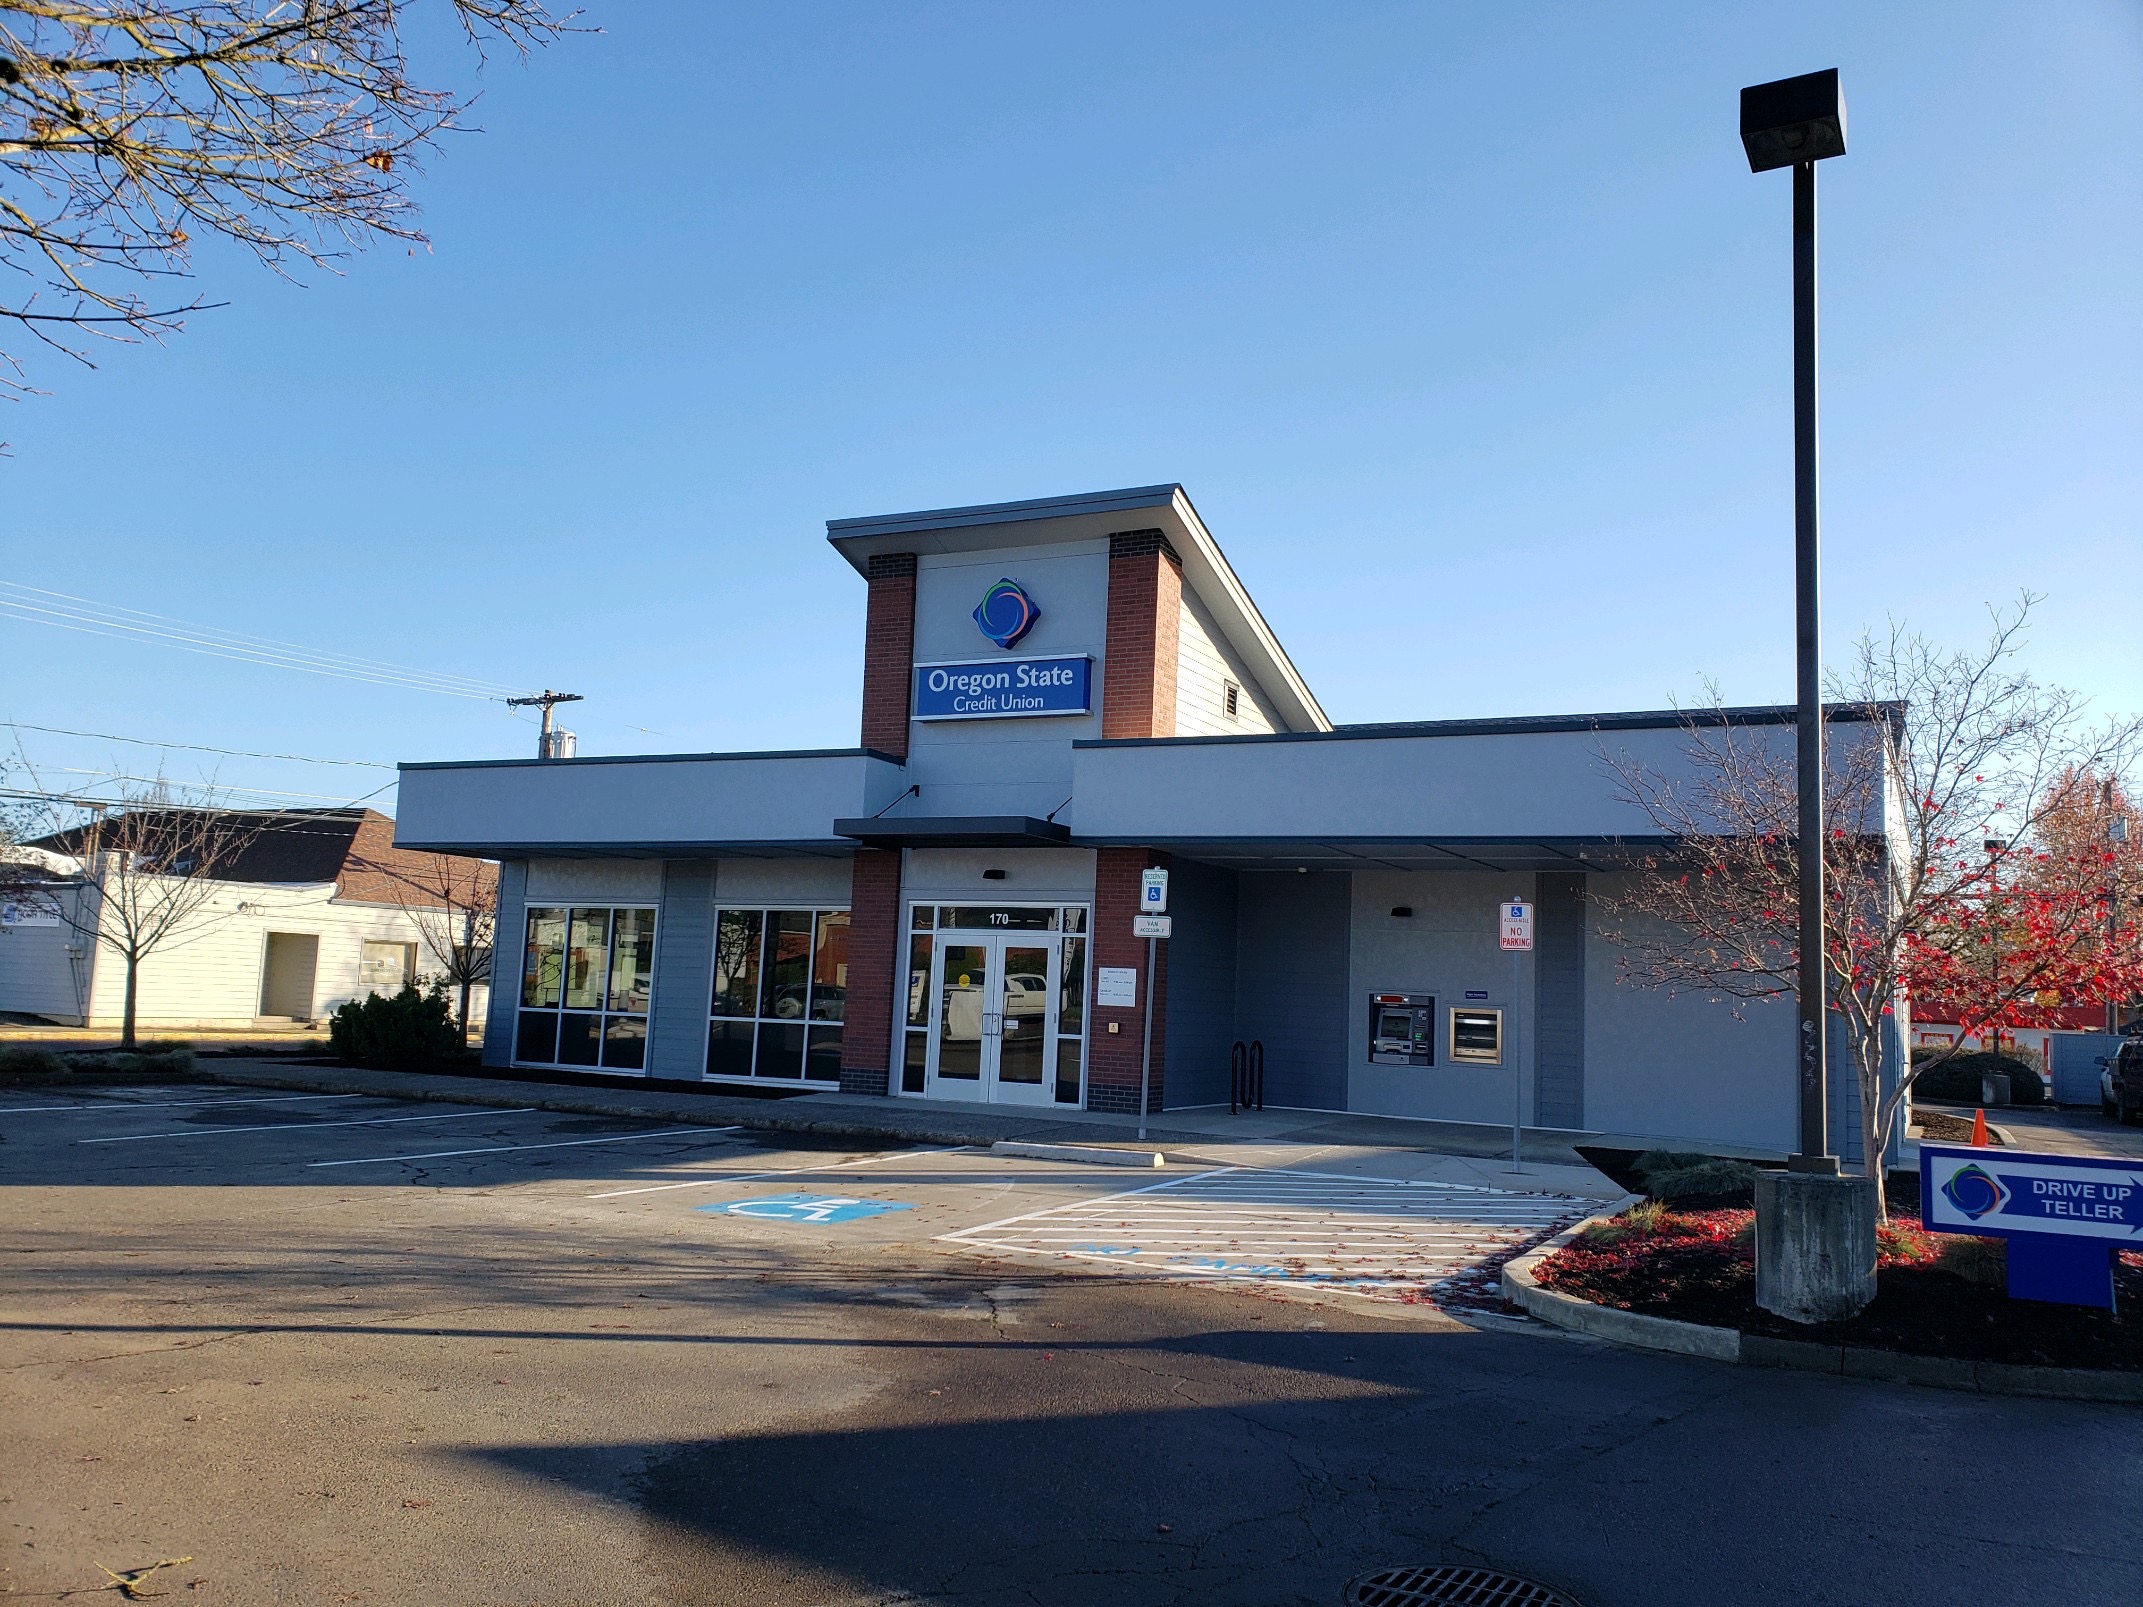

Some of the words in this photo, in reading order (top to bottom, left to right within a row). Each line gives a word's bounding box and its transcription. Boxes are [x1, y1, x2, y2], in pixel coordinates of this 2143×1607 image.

[928, 669, 1010, 696] Oregon
[1016, 665, 1073, 688] State
[953, 694, 997, 712] Credit
[1001, 693, 1044, 710] Union
[989, 913, 1009, 925] 170
[1510, 927, 1523, 936] NO
[1503, 938, 1530, 947] PARKING
[2033, 1180, 2096, 1199] DRIVE
[2103, 1185, 2132, 1201] UP
[2041, 1199, 2125, 1220] TELLER
